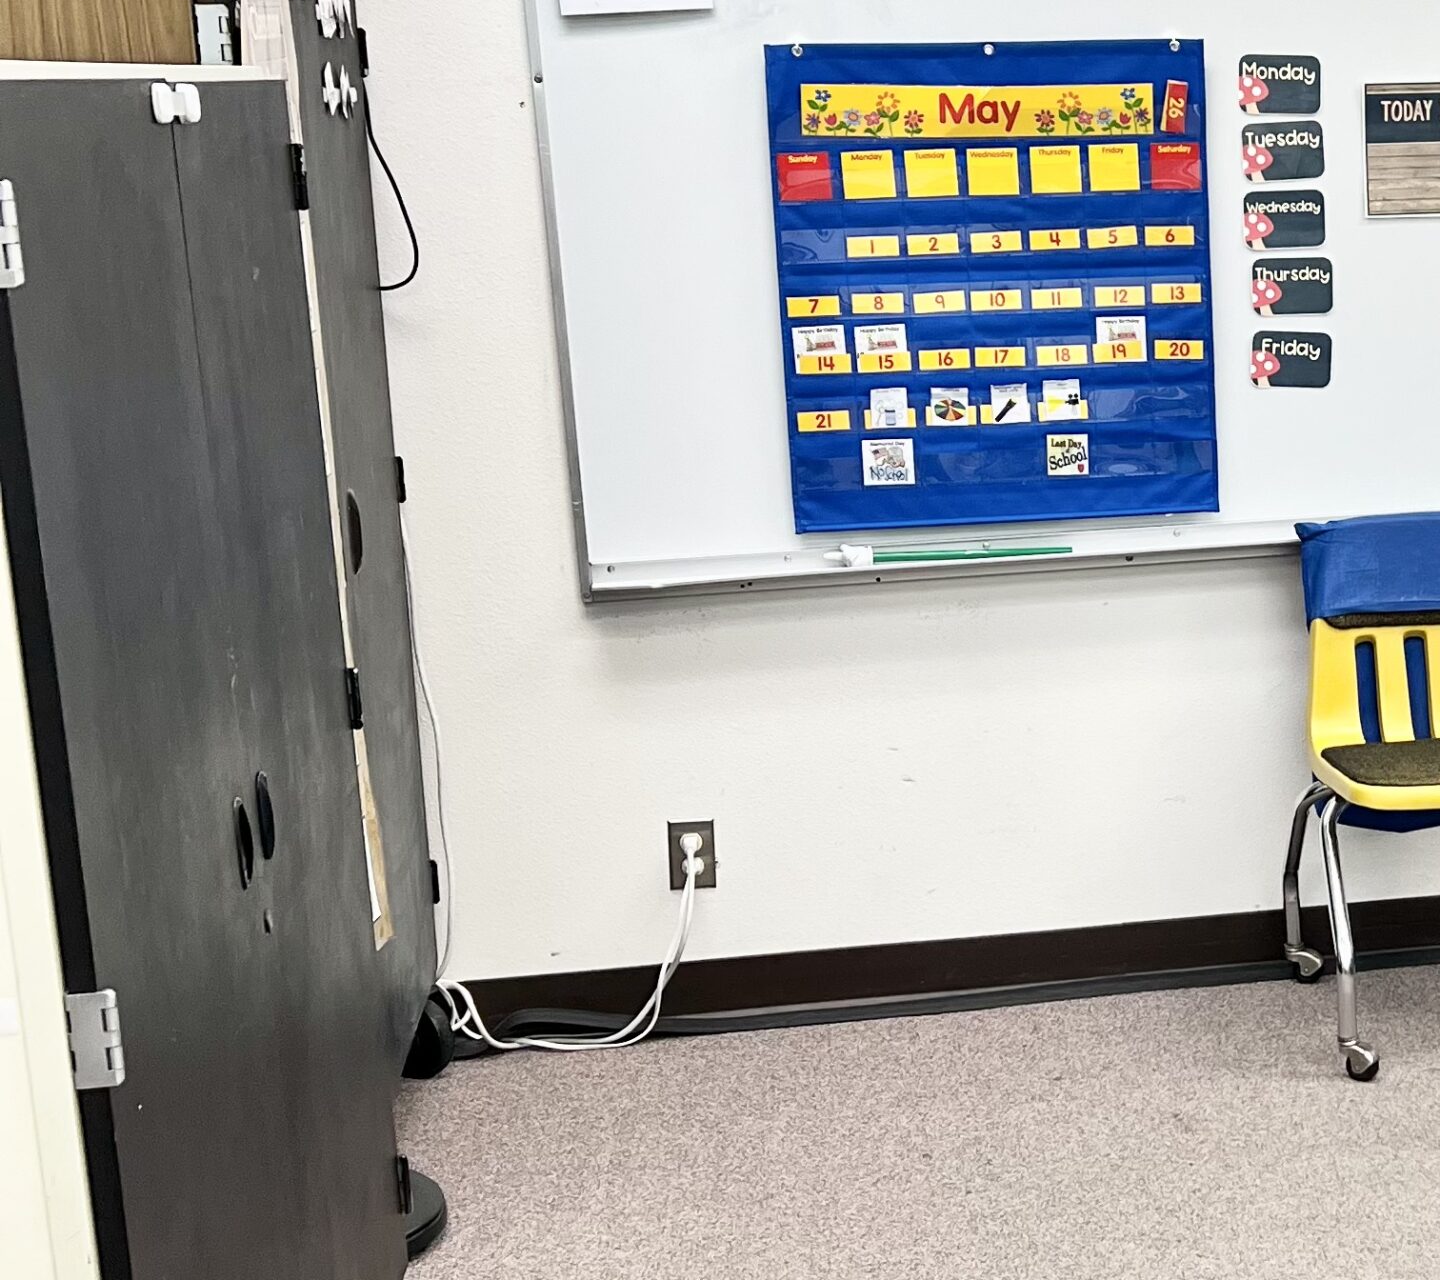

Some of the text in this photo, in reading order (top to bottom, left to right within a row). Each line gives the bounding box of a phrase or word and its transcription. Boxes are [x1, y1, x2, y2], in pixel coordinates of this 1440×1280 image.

[1242, 61, 1316, 85] Monday
[938, 93, 1021, 132] May
[1168, 97, 1185, 119] 26
[1380, 99, 1434, 123] TODAY
[1244, 130, 1321, 149] Tuesday
[851, 153, 882, 161] Monday
[915, 152, 945, 160] Tuesday
[970, 151, 1014, 159] Wednesday
[1038, 148, 1072, 157] Thursday
[1101, 147, 1124, 155] Friday
[1157, 145, 1192, 154] Saturday
[788, 155, 818, 164] Sunday
[1246, 200, 1321, 216] Wednesday
[991, 235, 1001, 250] 3
[1050, 231, 1061, 246] 4
[1107, 229, 1118, 244] 5
[1165, 229, 1175, 243] 6
[870, 239, 875, 255] 1
[928, 237, 939, 251] 2
[1254, 266, 1331, 285] Thursday
[989, 293, 1006, 307] 10
[1052, 292, 1061, 306] 11
[1114, 289, 1129, 304] 12
[1170, 286, 1185, 300] 13
[809, 298, 819, 313] 7
[873, 296, 884, 311] 8
[935, 295, 945, 309] 9
[994, 348, 1009, 363] 17
[1056, 347, 1071, 362] 18
[1111, 343, 1127, 358] 19
[1169, 342, 1190, 356] 20
[1261, 339, 1321, 361] Friday
[818, 356, 835, 371] 14
[878, 354, 894, 370] 15
[938, 351, 954, 367] 16
[815, 414, 832, 429] 21
[1051, 438, 1082, 450] Last Day
[1049, 446, 1088, 470] School
